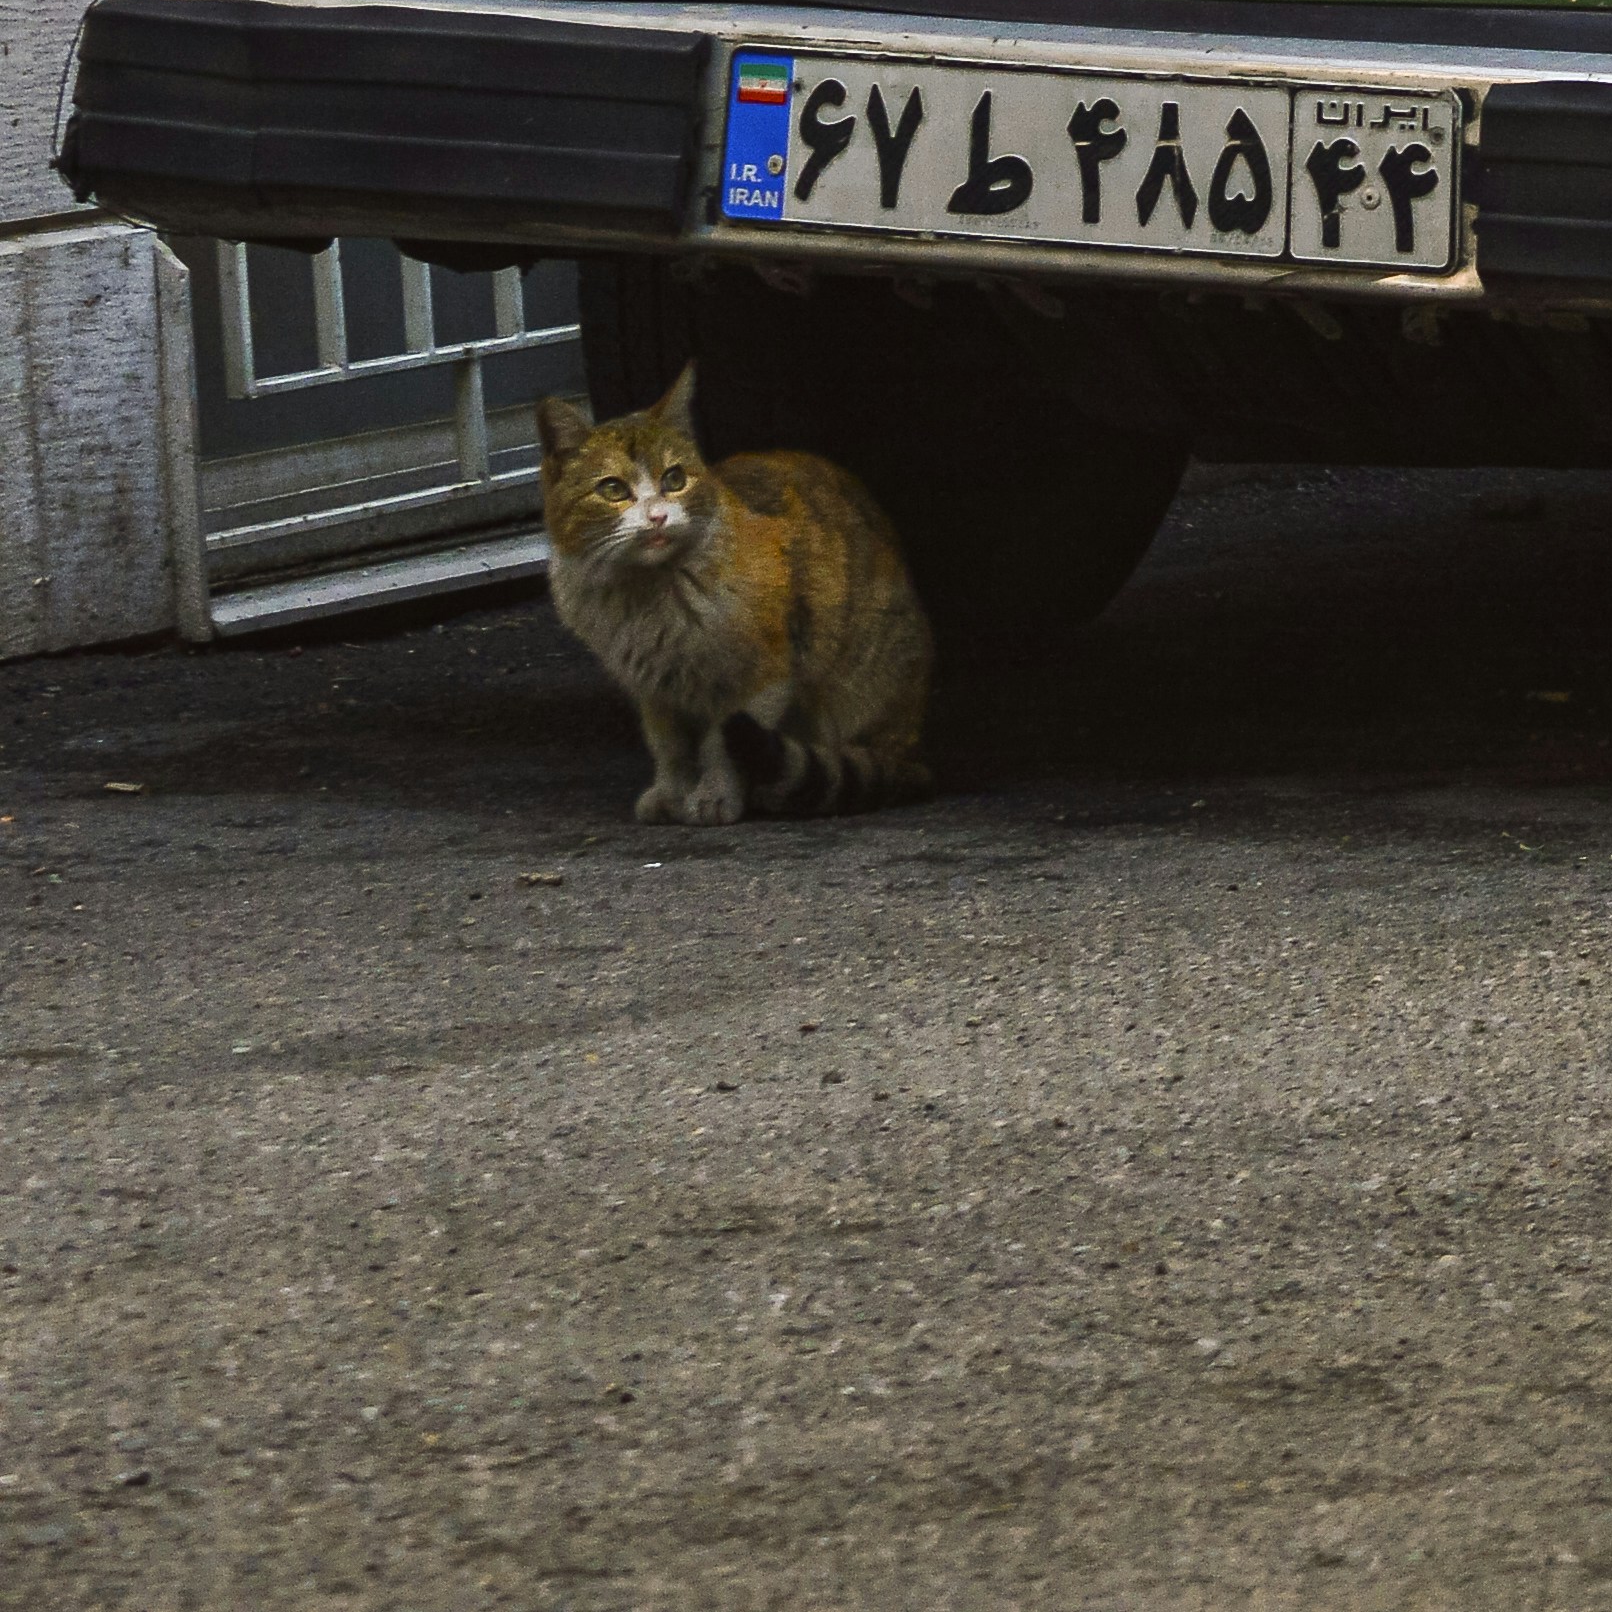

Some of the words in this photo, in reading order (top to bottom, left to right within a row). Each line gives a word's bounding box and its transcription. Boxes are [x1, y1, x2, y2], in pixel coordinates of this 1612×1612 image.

[1315, 100, 1430, 131] ایران
[946, 89, 1034, 216] ط
[729, 163, 762, 183] I.R.
[728, 188, 779, 208] IRAN
[1304, 137, 1440, 253] ۴۴
